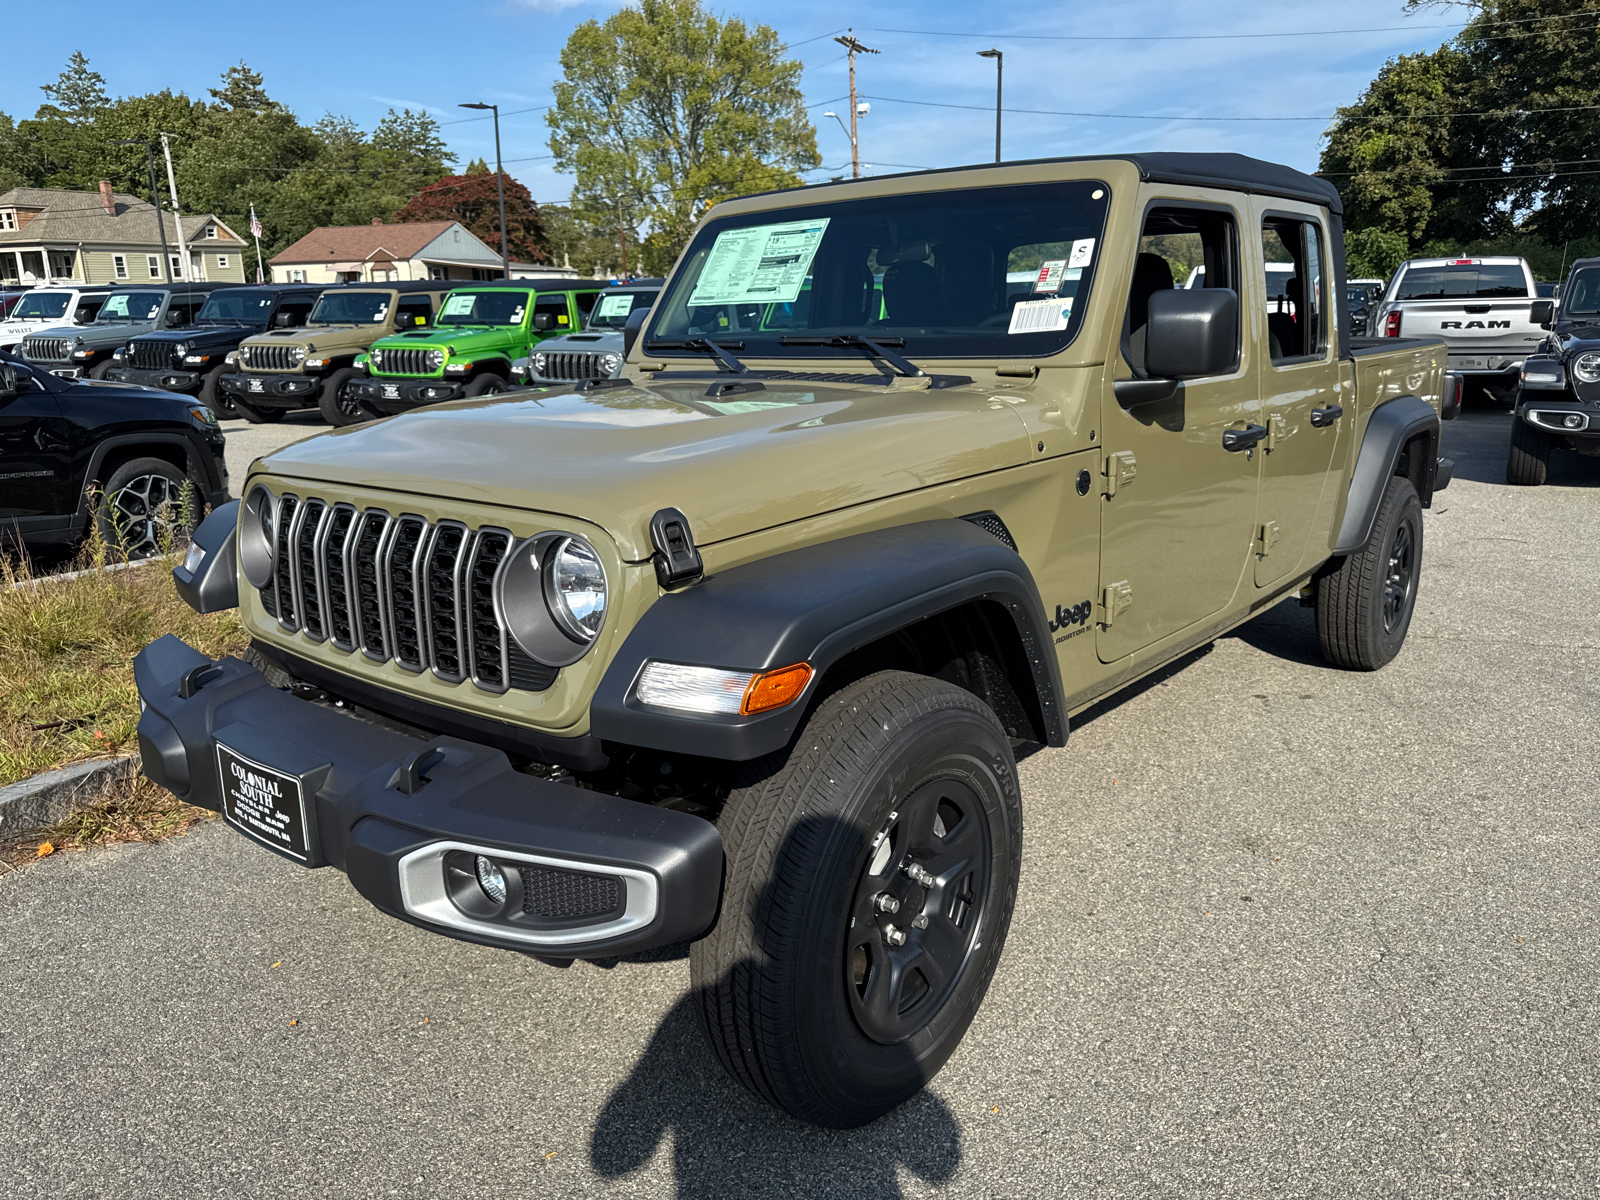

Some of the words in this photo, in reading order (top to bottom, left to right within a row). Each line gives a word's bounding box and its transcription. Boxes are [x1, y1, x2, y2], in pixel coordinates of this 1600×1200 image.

[1441, 320, 1511, 329] RAM
[1048, 599, 1092, 633] Jeep
[1054, 627, 1086, 646] ADIATOR
[231, 762, 282, 798] COLONIAL
[240, 781, 274, 808] SOUTH
[231, 789, 270, 815] CHRYSLER
[275, 810, 290, 824] Jeep
[236, 800, 261, 819] DODGE
[265, 816, 285, 830] RAM
